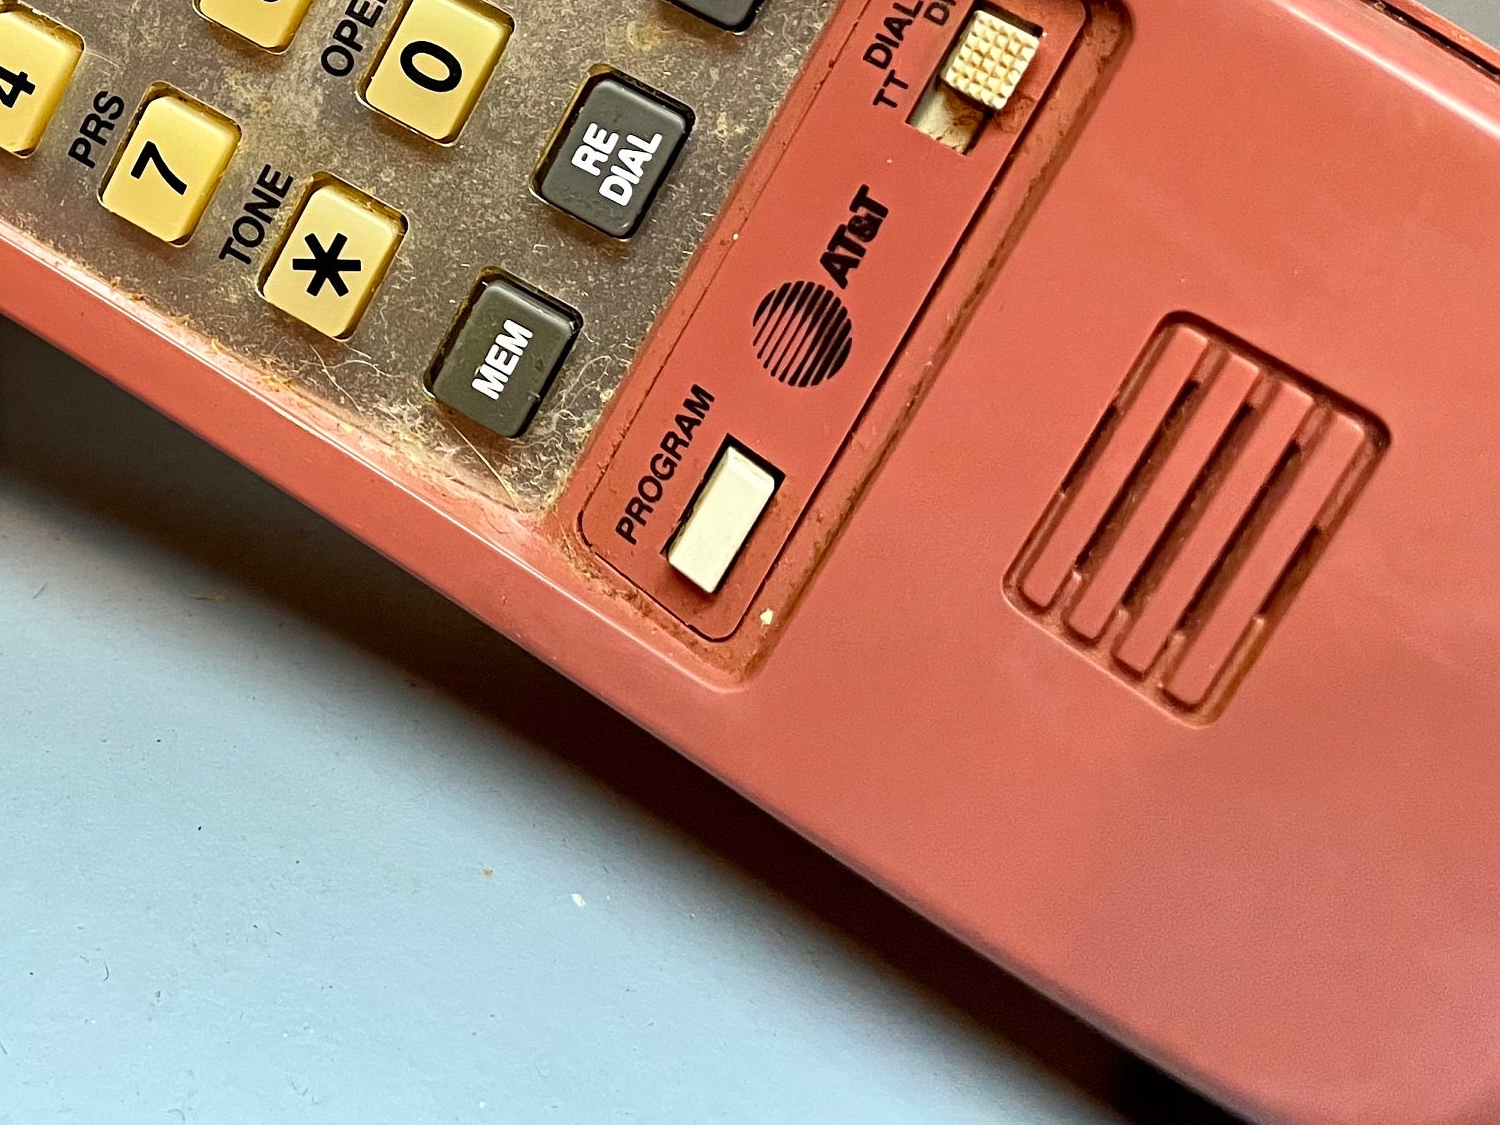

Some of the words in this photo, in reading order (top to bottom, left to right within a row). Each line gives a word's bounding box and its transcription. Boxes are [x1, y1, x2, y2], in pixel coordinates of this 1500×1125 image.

[399, 40, 463, 93] 0
[862, 0, 924, 70] DIAL
[872, 69, 909, 108] TT
[67, 89, 127, 169] PRS
[571, 122, 620, 176] RE
[130, 141, 189, 196] 7
[599, 130, 663, 207] DIAL
[217, 164, 294, 269] TONE
[820, 183, 889, 290] AT&T
[471, 319, 534, 401] MEM
[615, 383, 715, 545] PROGRAM
